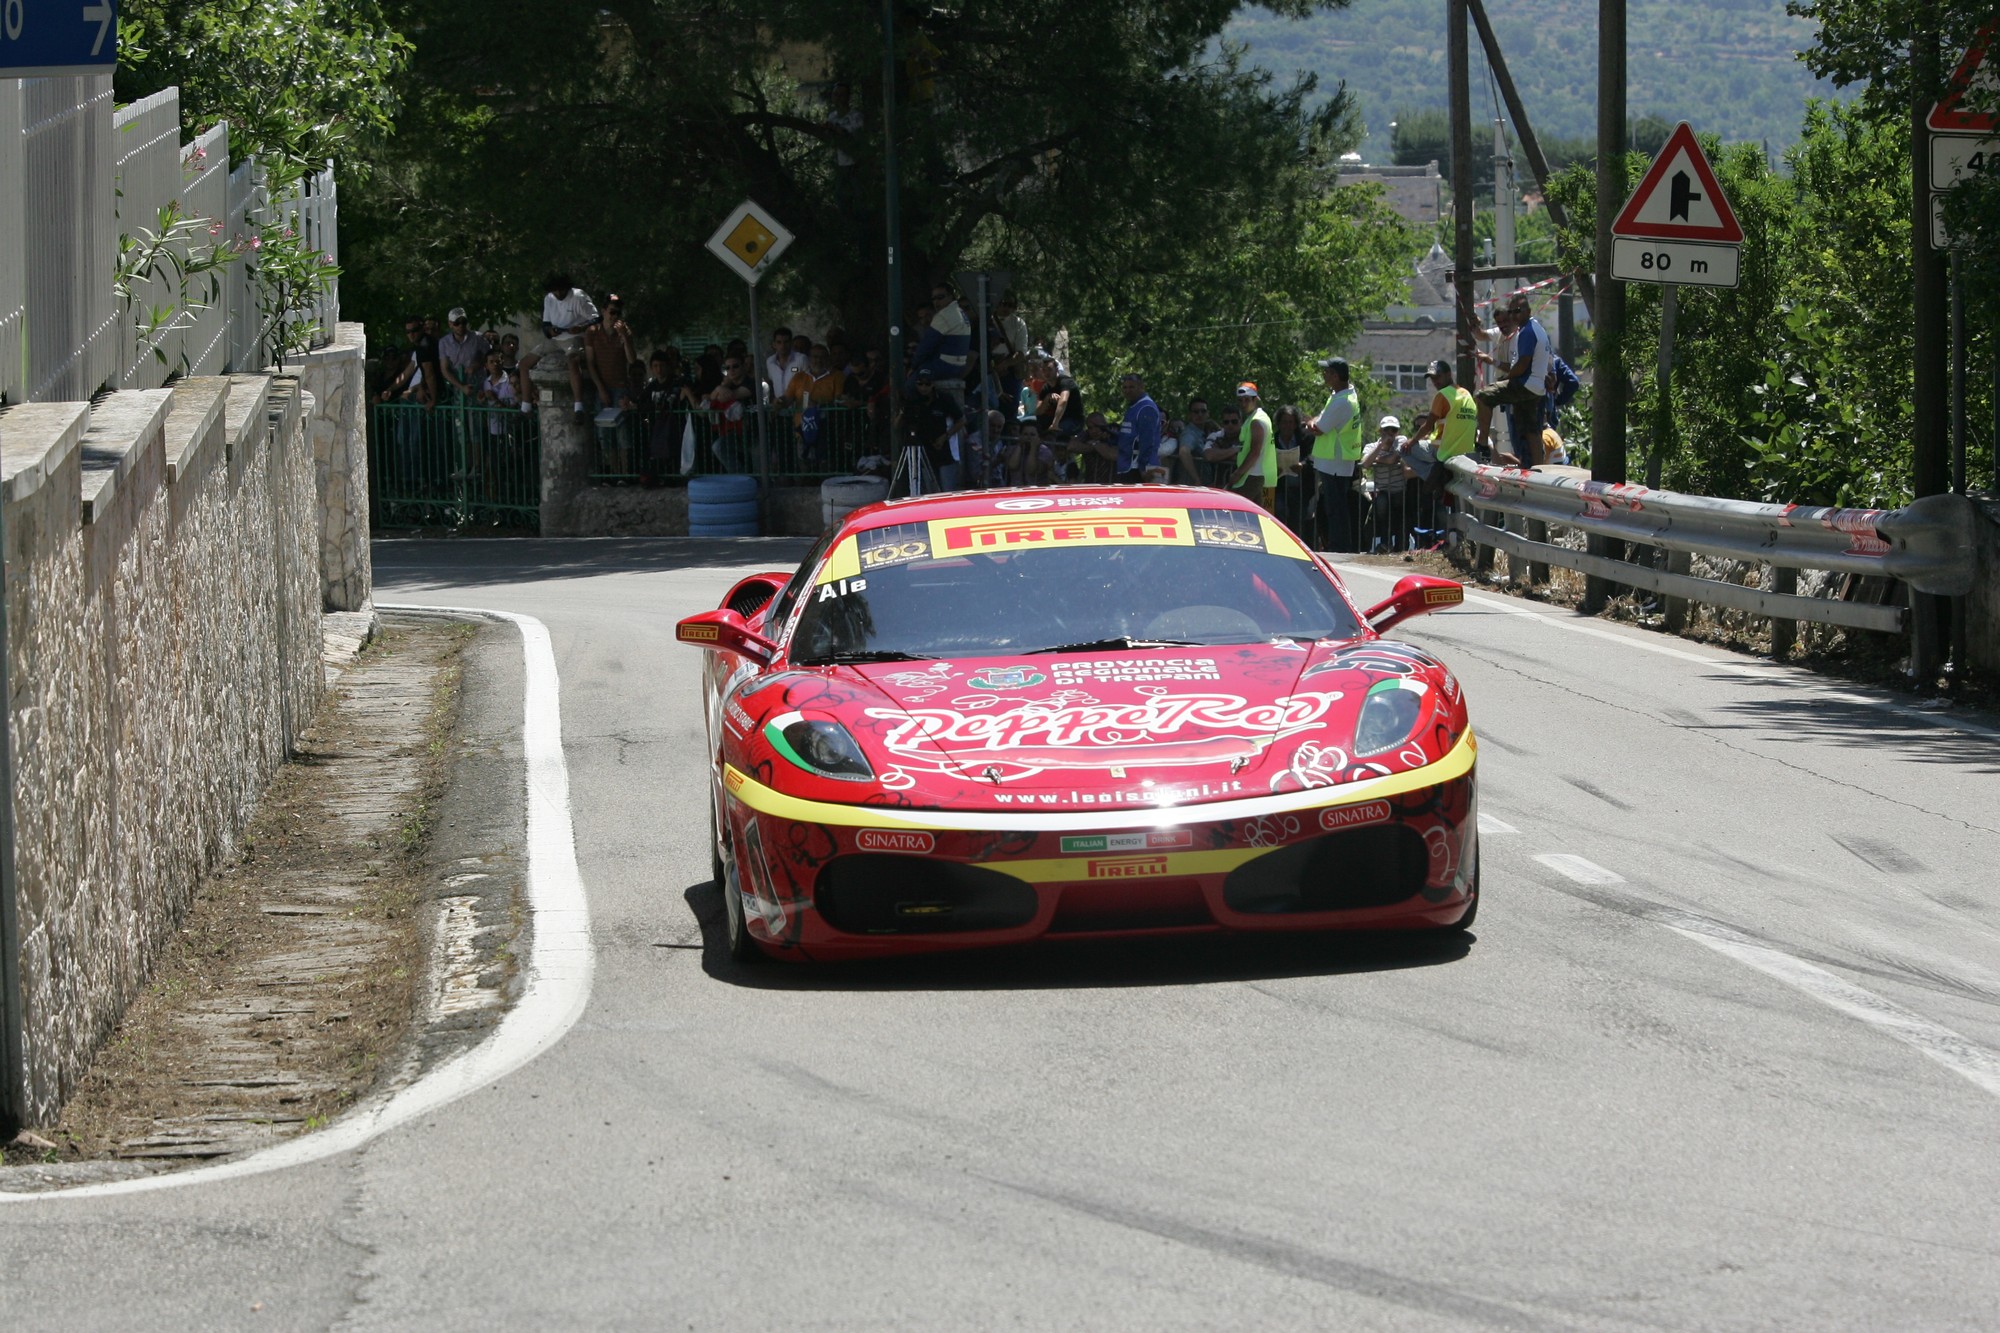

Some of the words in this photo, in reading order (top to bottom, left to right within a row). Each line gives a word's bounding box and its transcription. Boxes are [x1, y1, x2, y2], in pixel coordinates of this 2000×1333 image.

[1641, 252, 1671, 270] 80
[1690, 260, 1708, 273] m
[944, 517, 1178, 550] PIRELLI
[1194, 528, 1261, 545] 100
[861, 542, 927, 564] 100
[818, 578, 867, 603] Ale
[1427, 590, 1461, 603] PIRELLI
[681, 625, 716, 639] PIRELLI
[1050, 658, 1216, 671] PROVINCIA
[1053, 665, 1218, 678] REGIONALE
[1055, 677, 1084, 685] DI
[1327, 805, 1384, 826] SINATRA
[865, 833, 926, 849] SINATRA
[1073, 839, 1104, 848] ITALIAN
[1110, 838, 1142, 846] ENERGY
[1151, 836, 1176, 844] DRINK
[1087, 856, 1168, 878] PIRELLI
